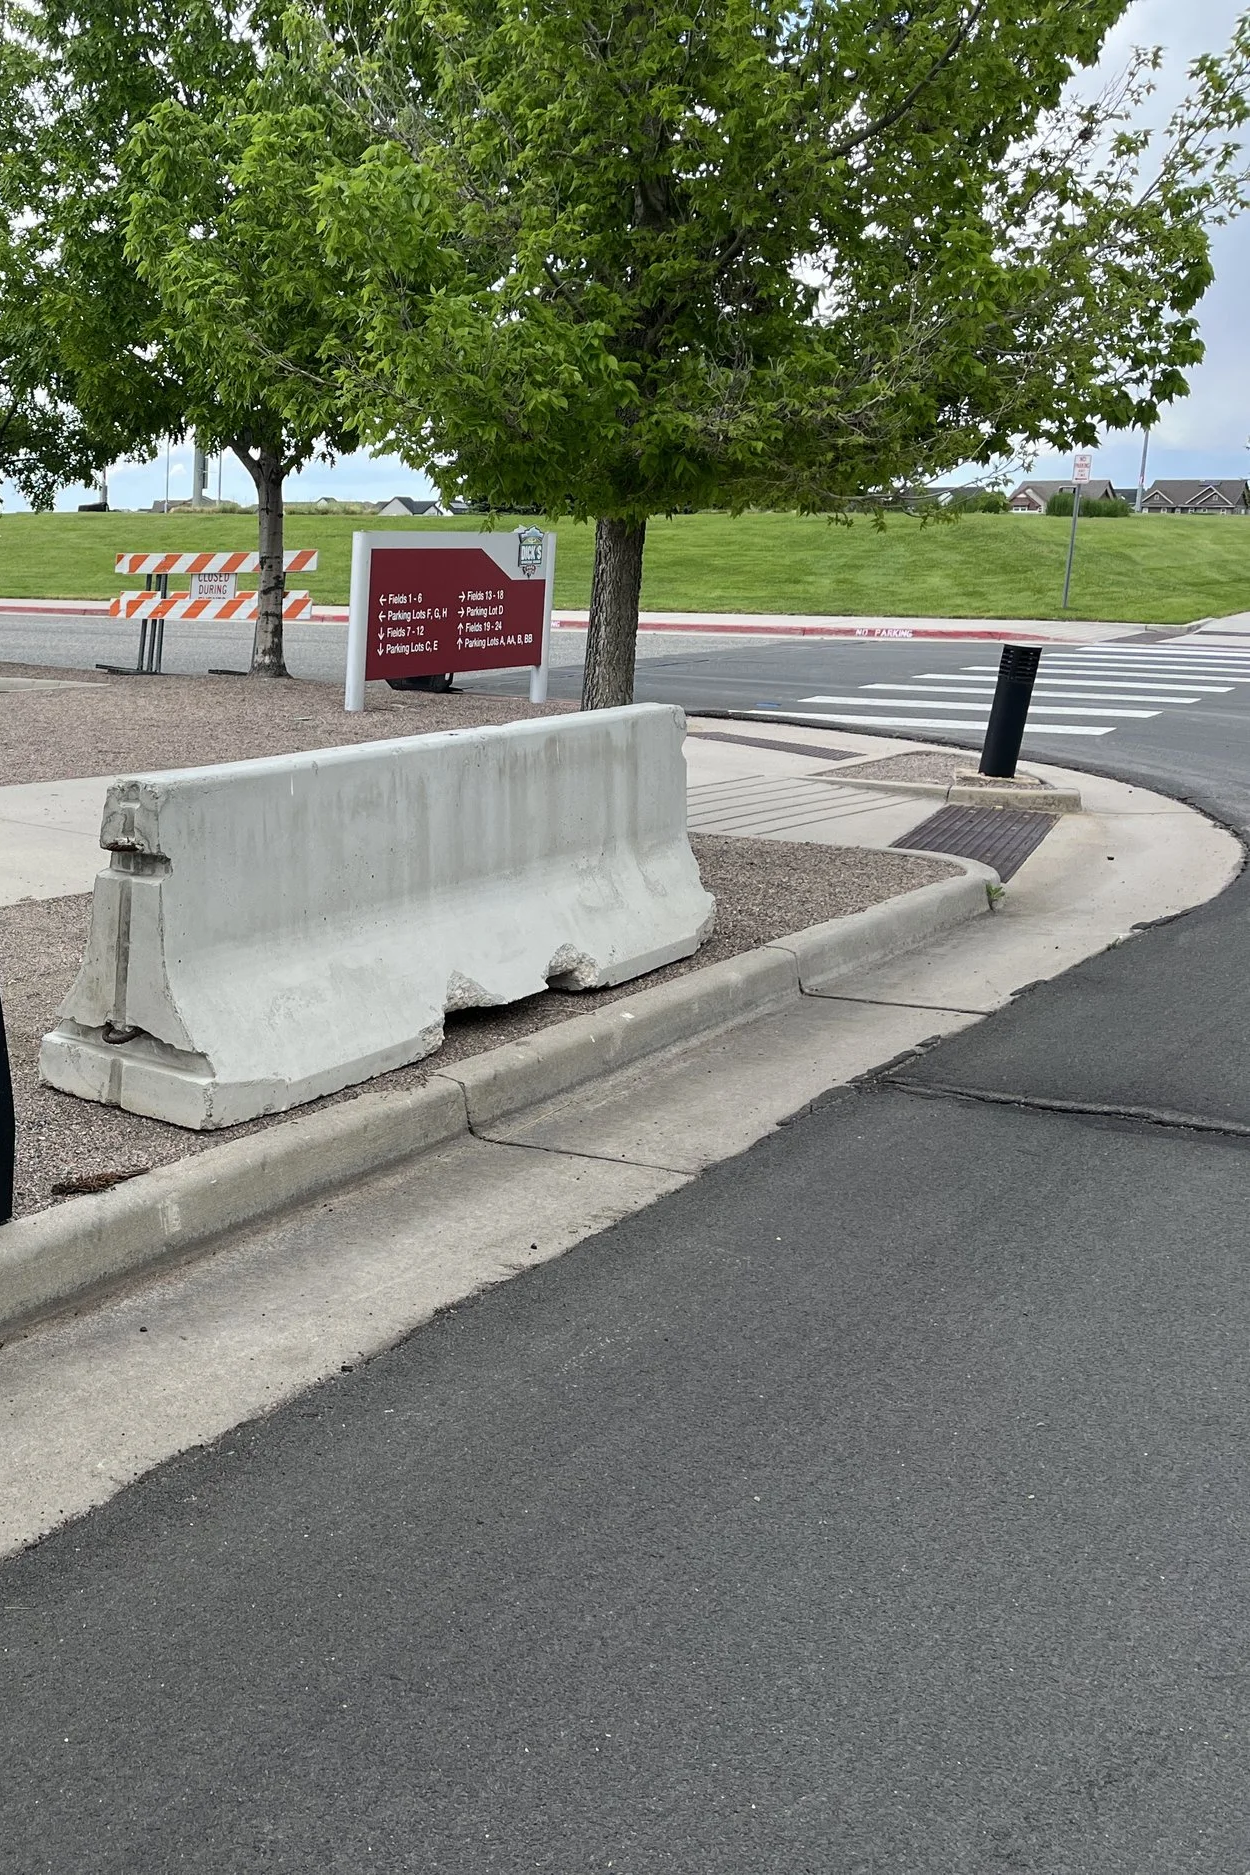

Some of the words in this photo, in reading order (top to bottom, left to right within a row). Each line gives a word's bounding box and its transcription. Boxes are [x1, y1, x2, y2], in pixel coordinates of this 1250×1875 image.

[521, 545, 541, 560] DICK'S
[198, 573, 230, 582] CLOSED
[198, 584, 227, 594] DURING
[388, 593, 407, 604] Fields
[409, 594, 412, 603] 1
[418, 593, 422, 603] 6
[467, 590, 484, 601] Fields
[485, 590, 492, 600] 13
[497, 590, 504, 600] 18
[387, 610, 411, 622] Parking
[412, 609, 426, 620] Lots
[427, 608, 432, 620] F,
[434, 608, 441, 619] G,
[442, 608, 448, 617] H
[466, 606, 488, 618] Parking
[489, 606, 498, 615] Lot
[499, 605, 504, 615] D
[387, 627, 406, 637] Fields
[407, 626, 411, 636] 7
[417, 626, 424, 635] 12
[465, 622, 482, 632] Fields
[484, 621, 491, 631] 19
[495, 621, 502, 630] 24
[874, 629, 912, 638] PARKING
[464, 637, 486, 649] Parking
[487, 637, 499, 646] Lots
[500, 636, 505, 647] A,
[507, 635, 516, 646] AA,
[517, 634, 523, 645] B,
[524, 634, 533, 644] BB
[386, 643, 409, 655] Parking
[411, 642, 424, 652] Lots
[425, 641, 432, 652] C,
[434, 640, 438, 650] E
